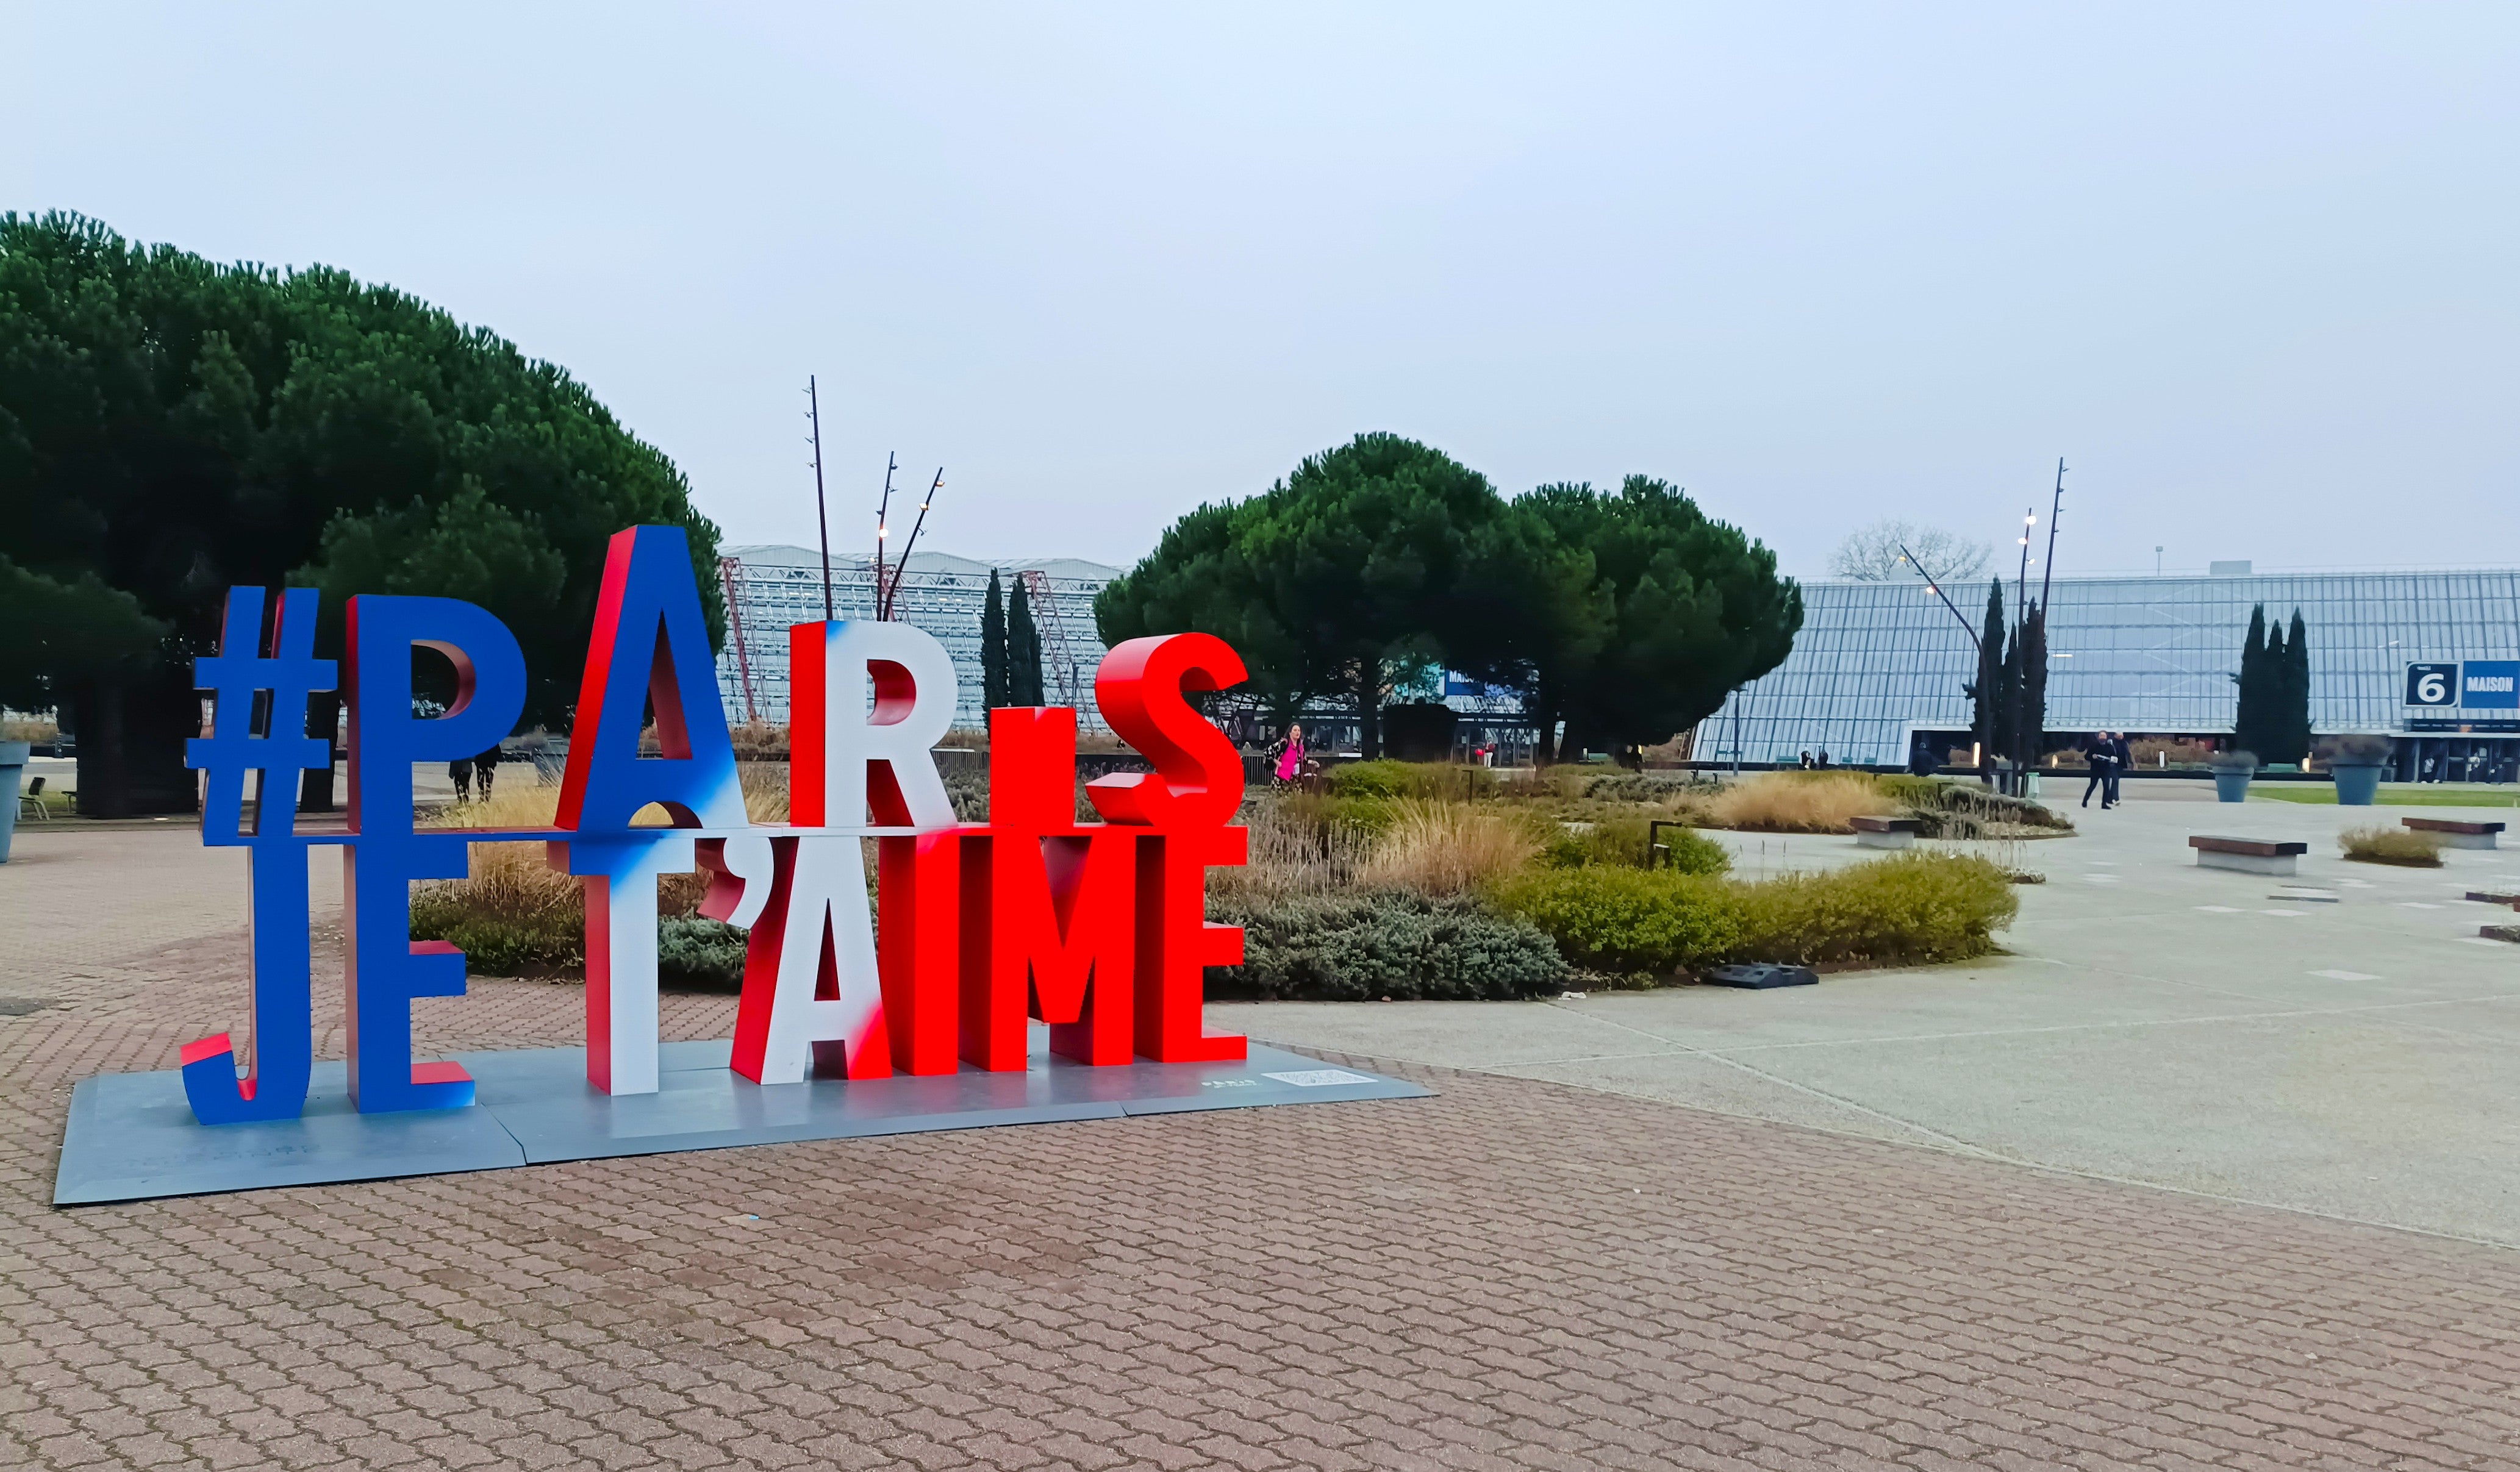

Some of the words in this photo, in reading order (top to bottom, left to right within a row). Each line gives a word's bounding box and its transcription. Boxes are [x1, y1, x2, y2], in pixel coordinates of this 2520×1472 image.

[185, 524, 1248, 837] #PARIS
[2418, 673, 2446, 702] 6
[2466, 677, 2513, 692] MAISON
[181, 834, 474, 1124] JE
[546, 827, 1248, 1096] T'AIME
